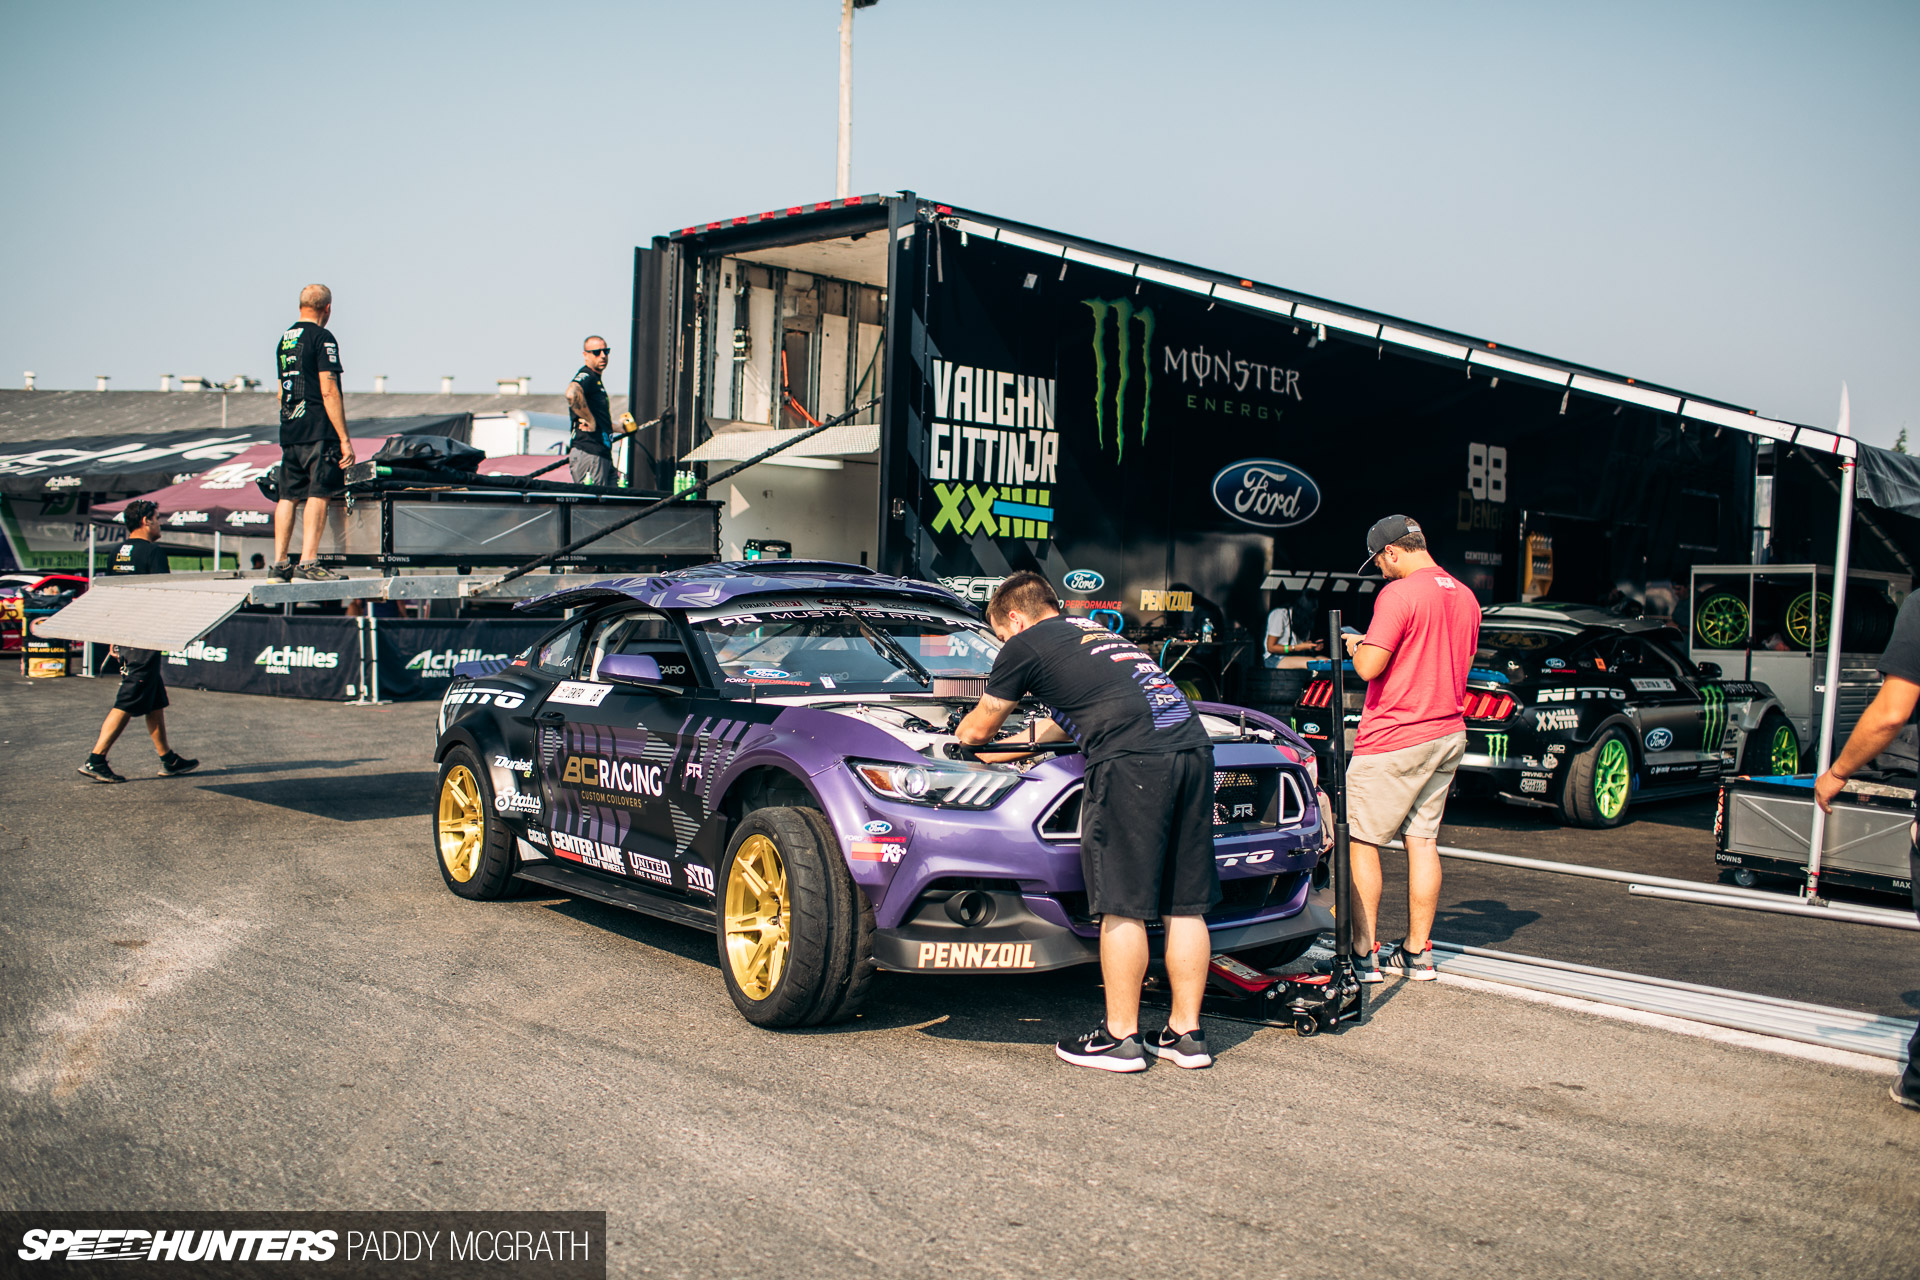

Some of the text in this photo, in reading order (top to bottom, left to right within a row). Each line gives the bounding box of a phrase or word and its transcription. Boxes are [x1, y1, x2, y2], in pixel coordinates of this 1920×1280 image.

[1164, 346, 1302, 401] MONSTER
[932, 359, 1055, 430] VAUGHN
[1187, 394, 1284, 422] ENERGY
[1468, 442, 1507, 503] 88
[1235, 467, 1302, 518] Ford
[167, 511, 208, 522] Achilles
[225, 511, 269, 523] Achilles
[1070, 572, 1097, 590] Ford
[1260, 569, 1385, 592] NITT
[738, 601, 774, 609] FORMULA
[1064, 600, 1122, 610] PERFORMANCE
[1140, 589, 1194, 612] PENNZOIL
[888, 612, 934, 623] RTR
[254, 645, 339, 669] Achilles
[421, 669, 450, 678] RADIAL
[659, 665, 686, 675] CARO
[748, 678, 811, 687] PERFORMANCE
[1536, 687, 1626, 703] NITTO
[1650, 731, 1668, 748] Ford
[493, 755, 533, 772] Duralast
[494, 786, 541, 811] Status
[581, 790, 642, 808] CUSTOM COILOVERS
[508, 805, 540, 815] SHADES
[551, 830, 596, 858] CENTER
[595, 841, 625, 867] LINE
[582, 856, 627, 875] ALLOY WHEELS
[628, 851, 672, 879] UNITED
[1716, 853, 1742, 864] DOWNS
[633, 869, 645, 879] TIRE
[651, 874, 673, 885] WHEELS
[1892, 879, 1911, 889] MAX
[917, 942, 1036, 969] PENNZOIL
